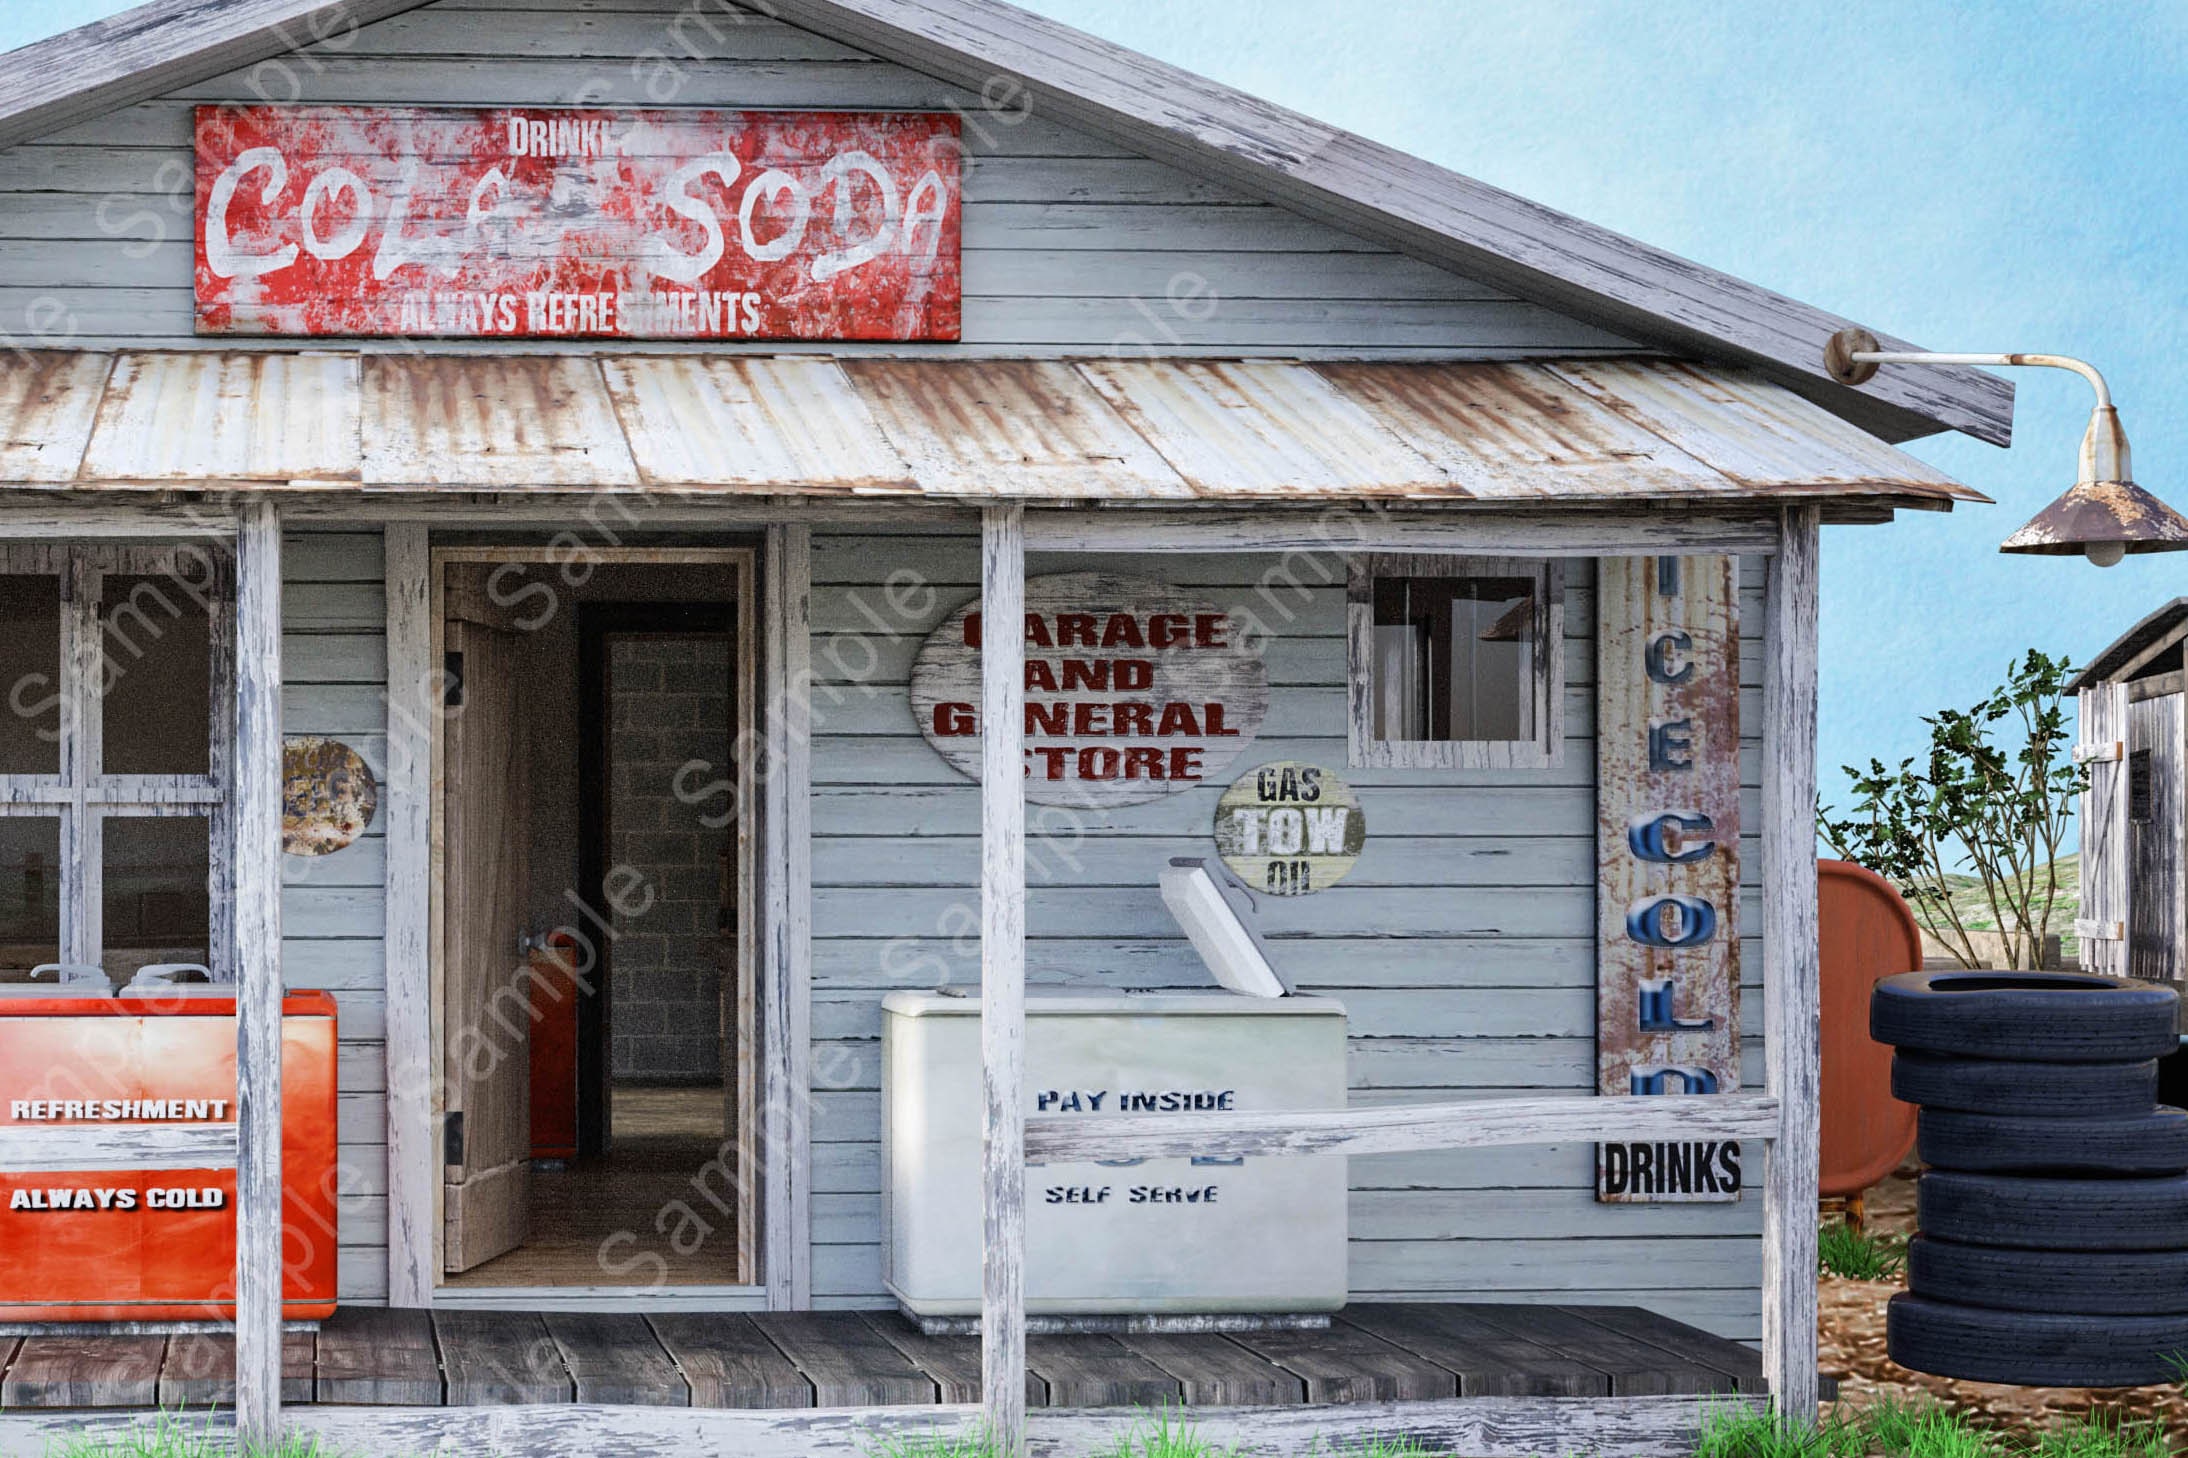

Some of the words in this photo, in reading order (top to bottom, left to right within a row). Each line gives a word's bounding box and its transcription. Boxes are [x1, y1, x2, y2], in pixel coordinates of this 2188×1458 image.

[206, 146, 510, 281] COLA
[648, 150, 948, 282] SODA
[527, 291, 762, 333] REFRESMENTS
[1024, 659, 1154, 693] AND
[933, 702, 1241, 738] GNERAL
[1024, 747, 1206, 782] TORE
[1257, 767, 1322, 802] GAS
[1232, 806, 1351, 857] TOW
[11, 1099, 229, 1121] REFRESHMENT
[1037, 1089, 1108, 1113] PAY
[1119, 1089, 1236, 1113] INSIDE
[1605, 1140, 1742, 1196] DRINKS
[9, 1187, 137, 1210] ALWAYS
[145, 1187, 226, 1210] COLD
[1044, 1185, 1112, 1204] SELF
[1128, 1185, 1220, 1204] SERVE
